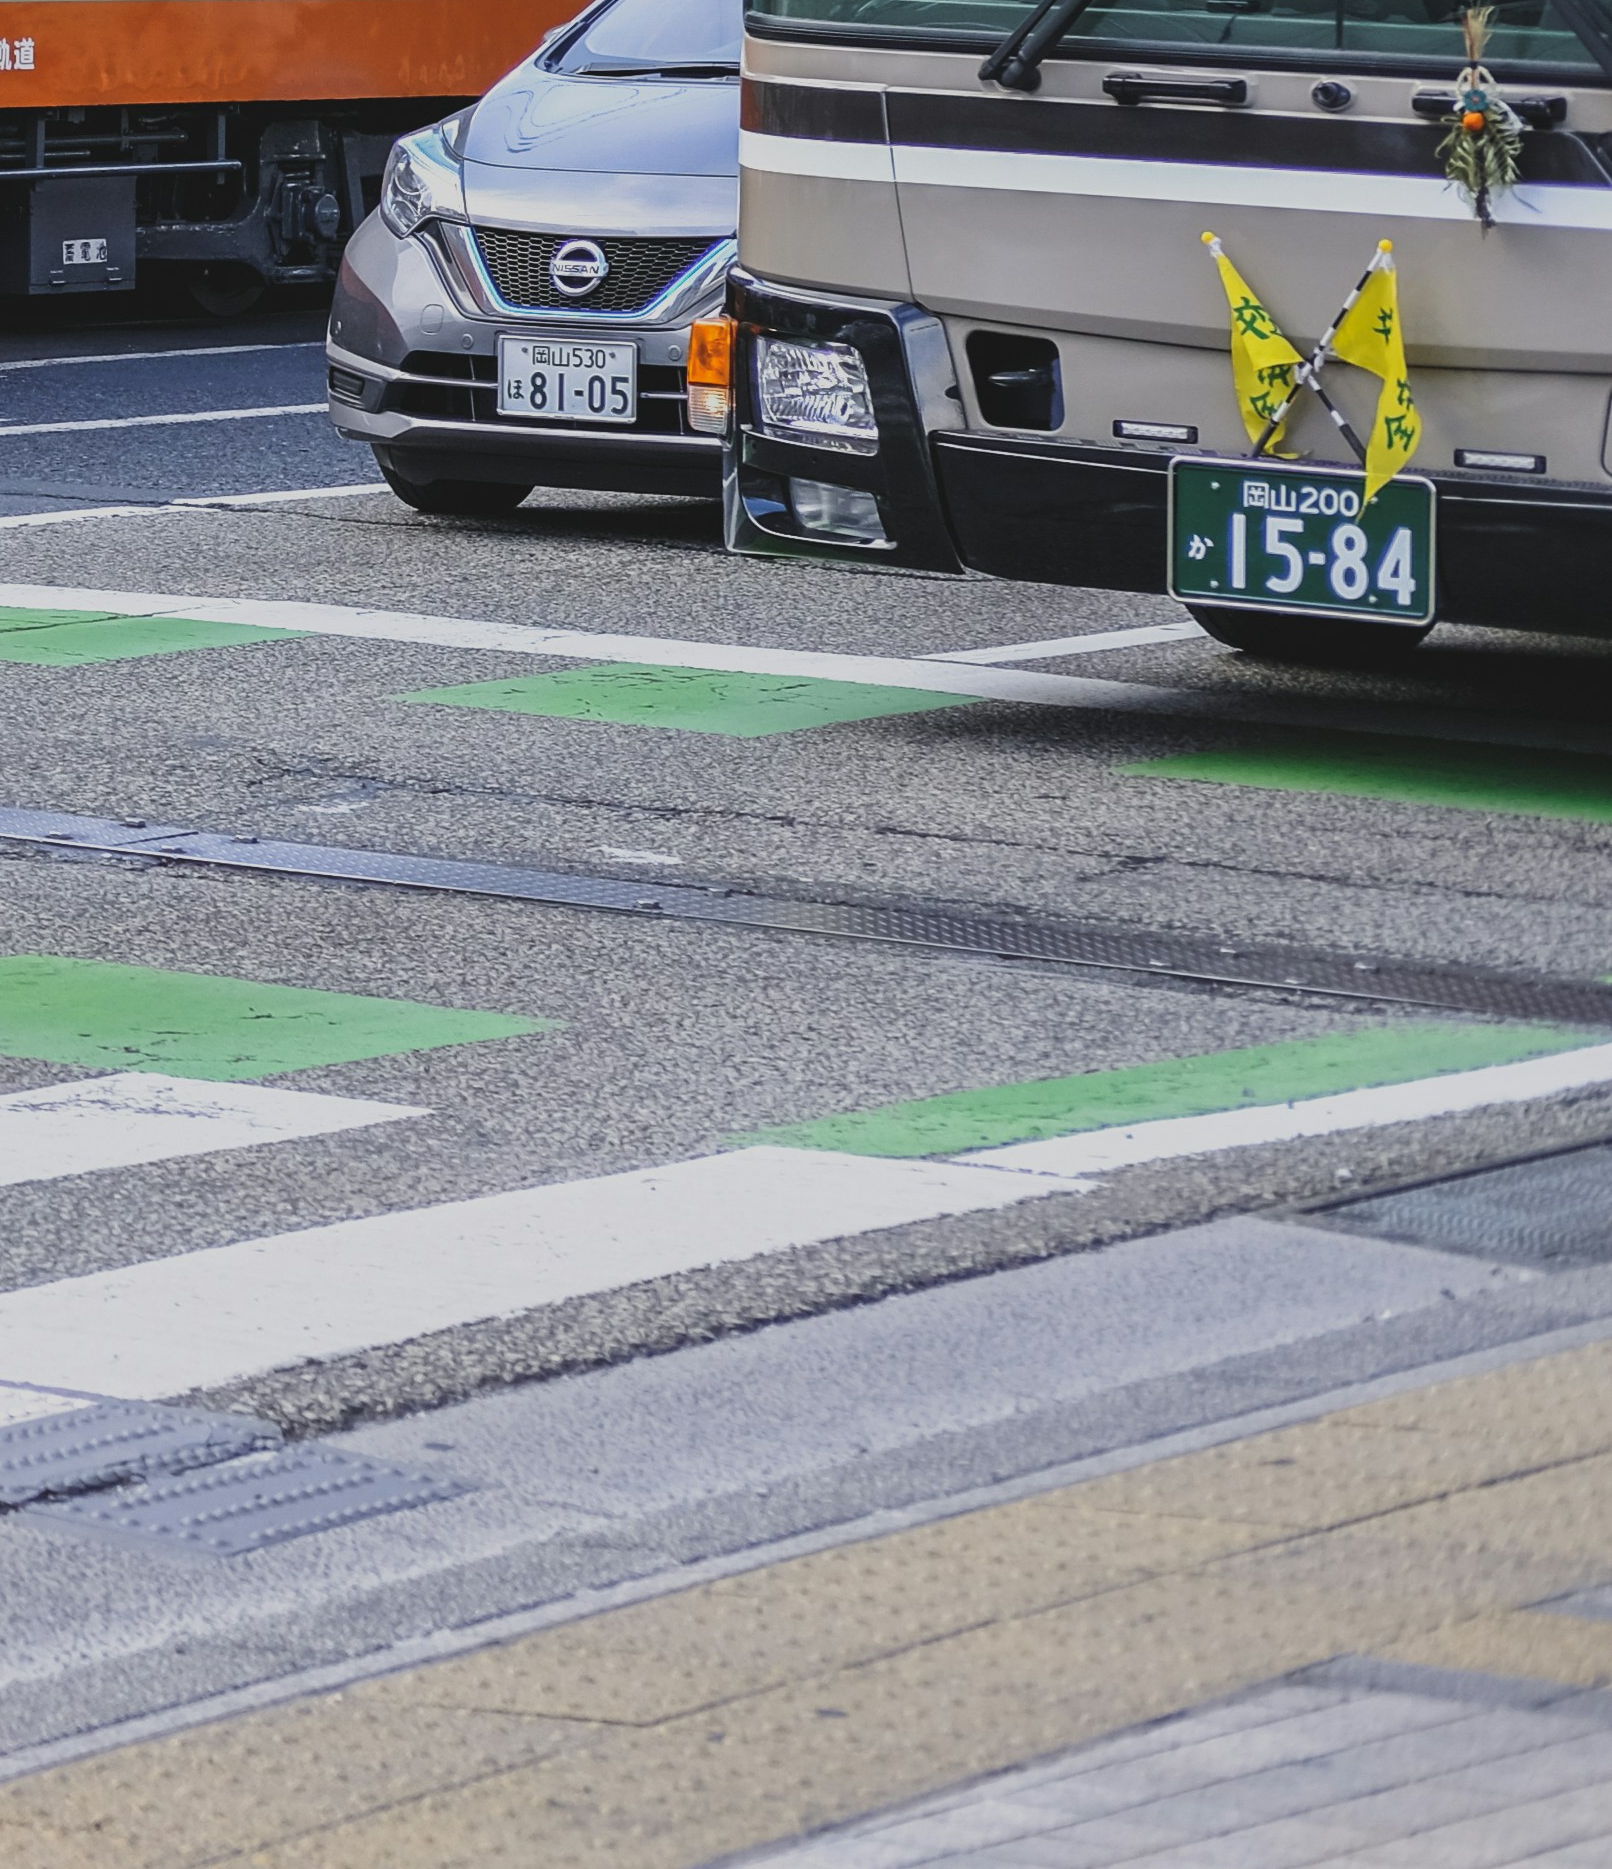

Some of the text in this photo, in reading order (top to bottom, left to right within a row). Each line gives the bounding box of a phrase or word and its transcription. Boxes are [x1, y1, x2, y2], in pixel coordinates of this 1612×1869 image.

[551, 262, 600, 275] NISSAN
[508, 371, 630, 415] ほ 81-05
[1187, 512, 1417, 606] か 15-84
